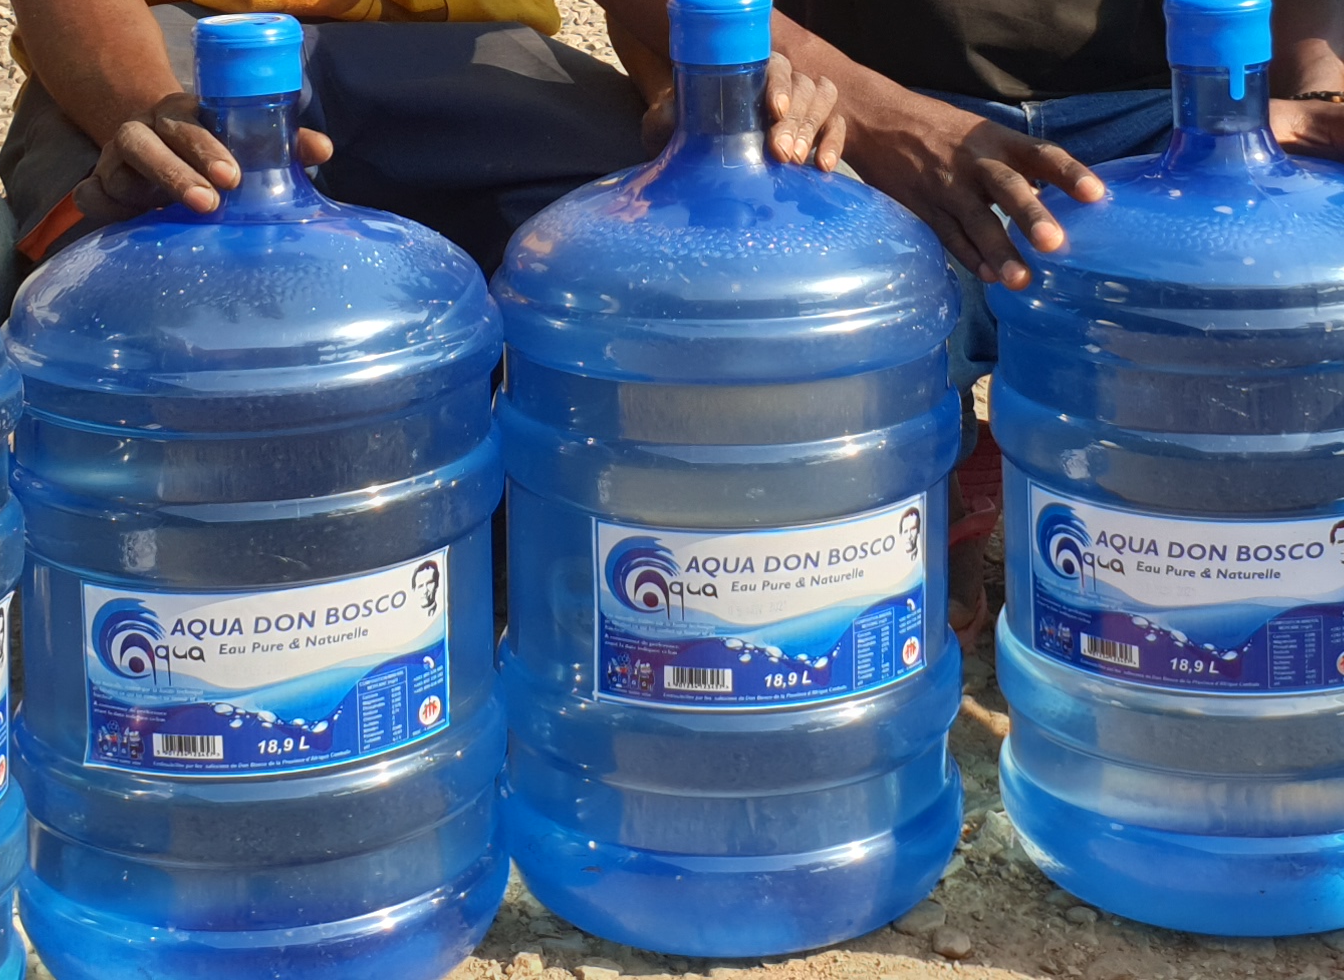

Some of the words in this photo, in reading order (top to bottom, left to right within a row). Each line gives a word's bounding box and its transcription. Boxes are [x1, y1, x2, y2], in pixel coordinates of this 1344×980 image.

[684, 555, 754, 574] AQUA
[763, 550, 820, 573] DON
[827, 535, 896, 566] BOSCO
[1095, 530, 1159, 557] AQUA
[1167, 541, 1227, 562] DON
[1236, 541, 1325, 562] BOSCO
[731, 580, 757, 592] Eau
[761, 576, 791, 592] Pure
[795, 576, 806, 588] &
[810, 567, 865, 587] Naturelle
[1136, 561, 1161, 574] Eau
[1165, 564, 1196, 578] Pure
[1200, 567, 1212, 579] &
[1216, 568, 1281, 580] Naturelle
[169, 618, 244, 637] AQUA
[253, 610, 316, 634] DON
[324, 591, 407, 627] BOSCO
[218, 642, 246, 656] Eau
[251, 638, 285, 654] Pure
[290, 638, 301, 650] &
[305, 626, 369, 648] Naturelle
[1170, 657, 1204, 674] 18,9
[1208, 661, 1220, 673] L
[764, 672, 798, 689] 18,9
[801, 670, 812, 685] L
[257, 737, 294, 755] 18,9
[299, 736, 311, 751] L
